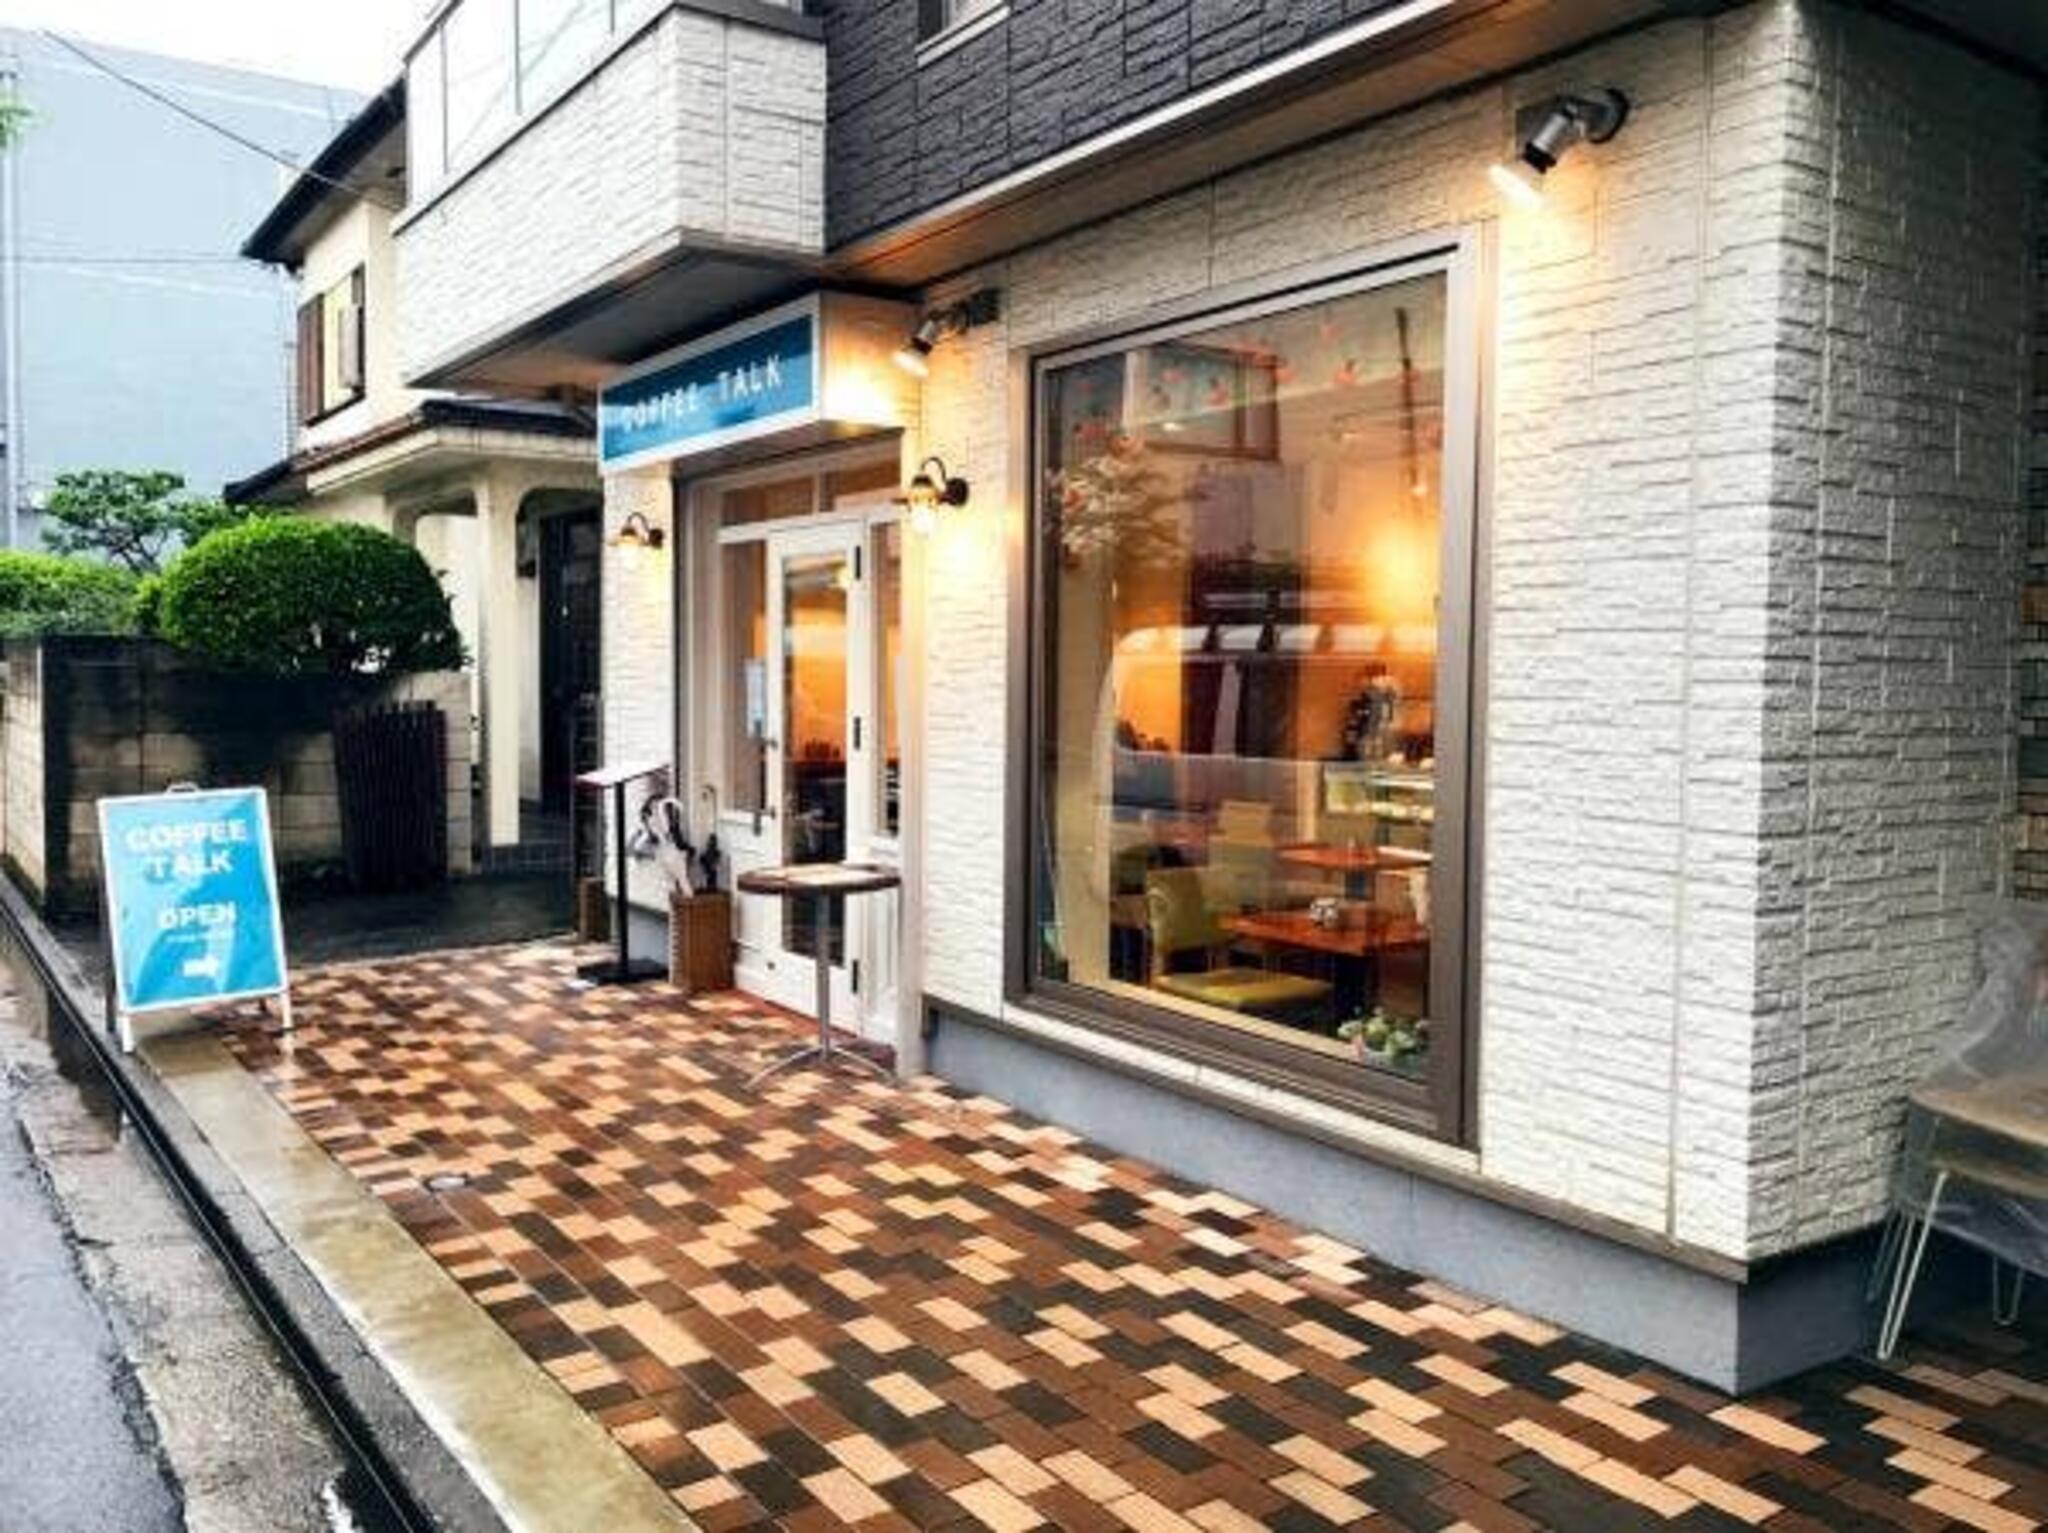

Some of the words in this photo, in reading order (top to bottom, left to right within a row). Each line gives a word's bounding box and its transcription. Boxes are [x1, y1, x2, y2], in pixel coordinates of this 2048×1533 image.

[718, 354, 783, 404] TALK
[126, 820, 247, 850] COFFEE
[147, 850, 233, 878] TALK
[159, 902, 236, 929] OPEN
